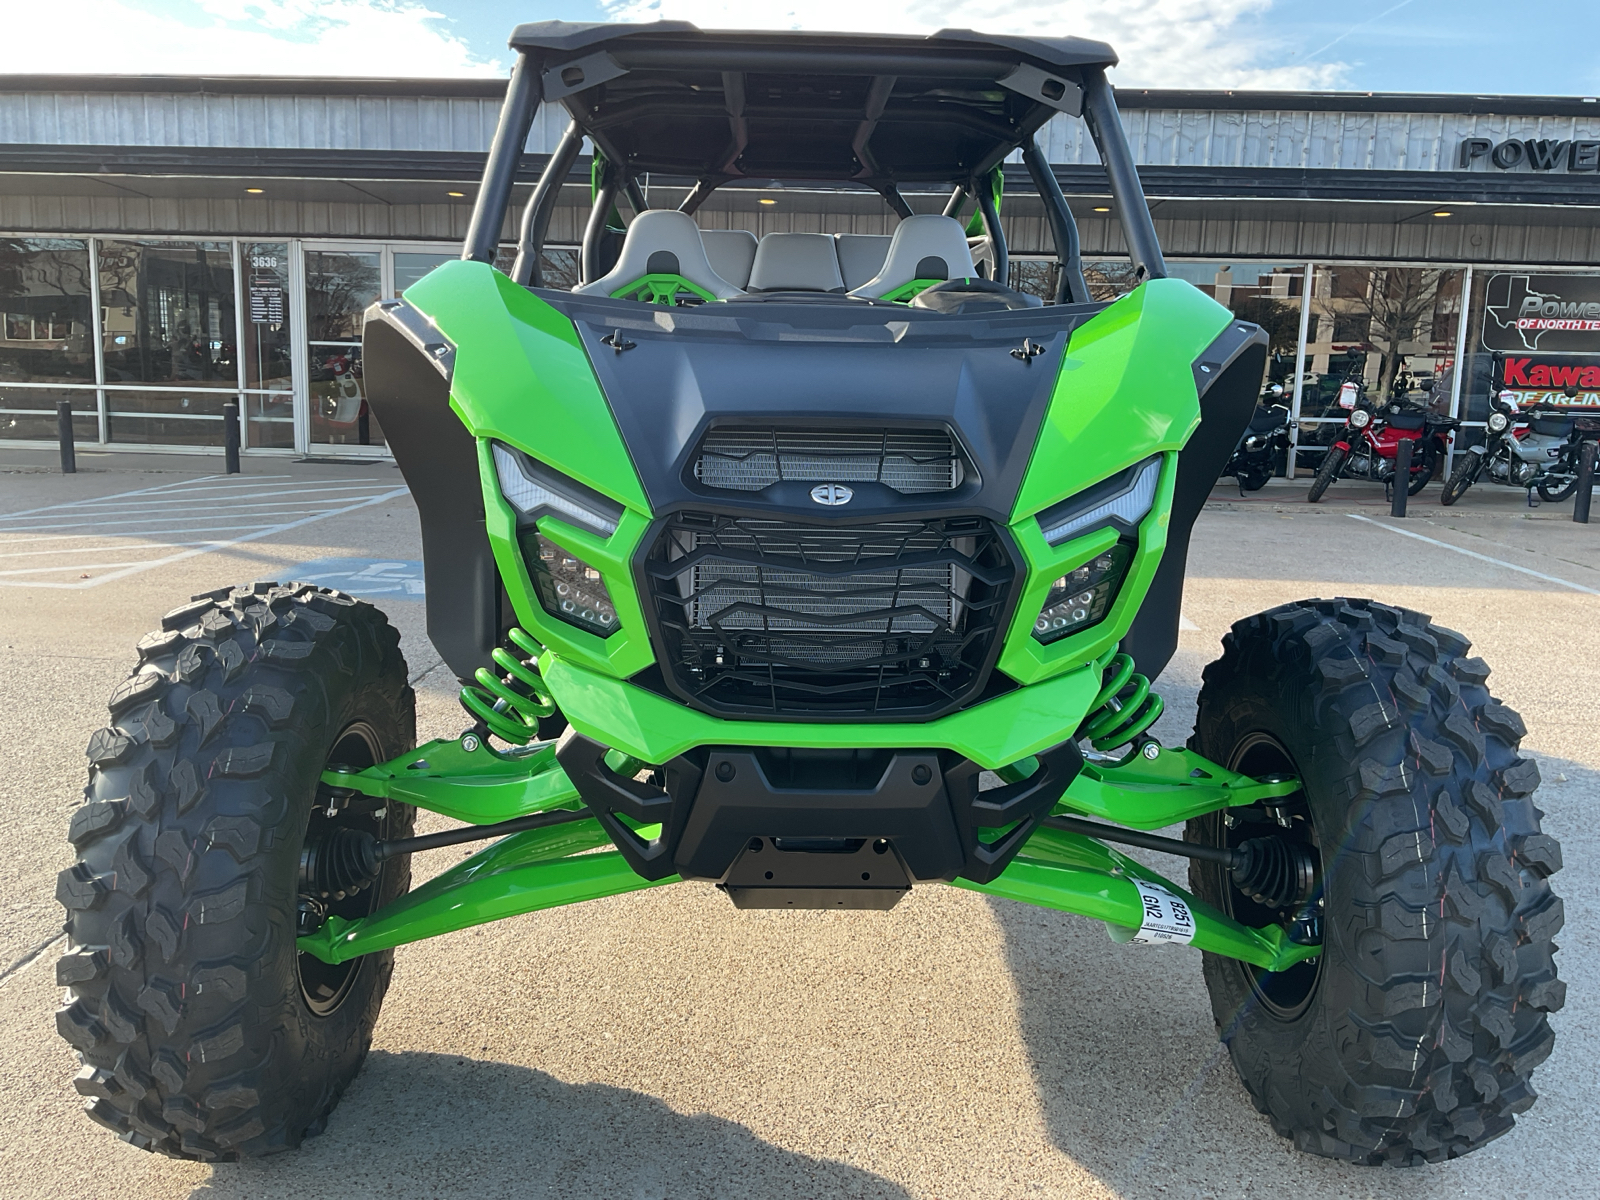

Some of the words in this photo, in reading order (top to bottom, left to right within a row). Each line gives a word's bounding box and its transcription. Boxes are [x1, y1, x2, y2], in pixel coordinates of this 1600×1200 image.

[1460, 138, 1600, 171] POWE
[253, 256, 277, 268] 3636
[1519, 297, 1600, 319] Powe
[1518, 319, 1537, 329] OF
[1537, 319, 1580, 330] NORTH
[1142, 895, 1163, 919] GN2
[1170, 900, 1191, 928] B251
